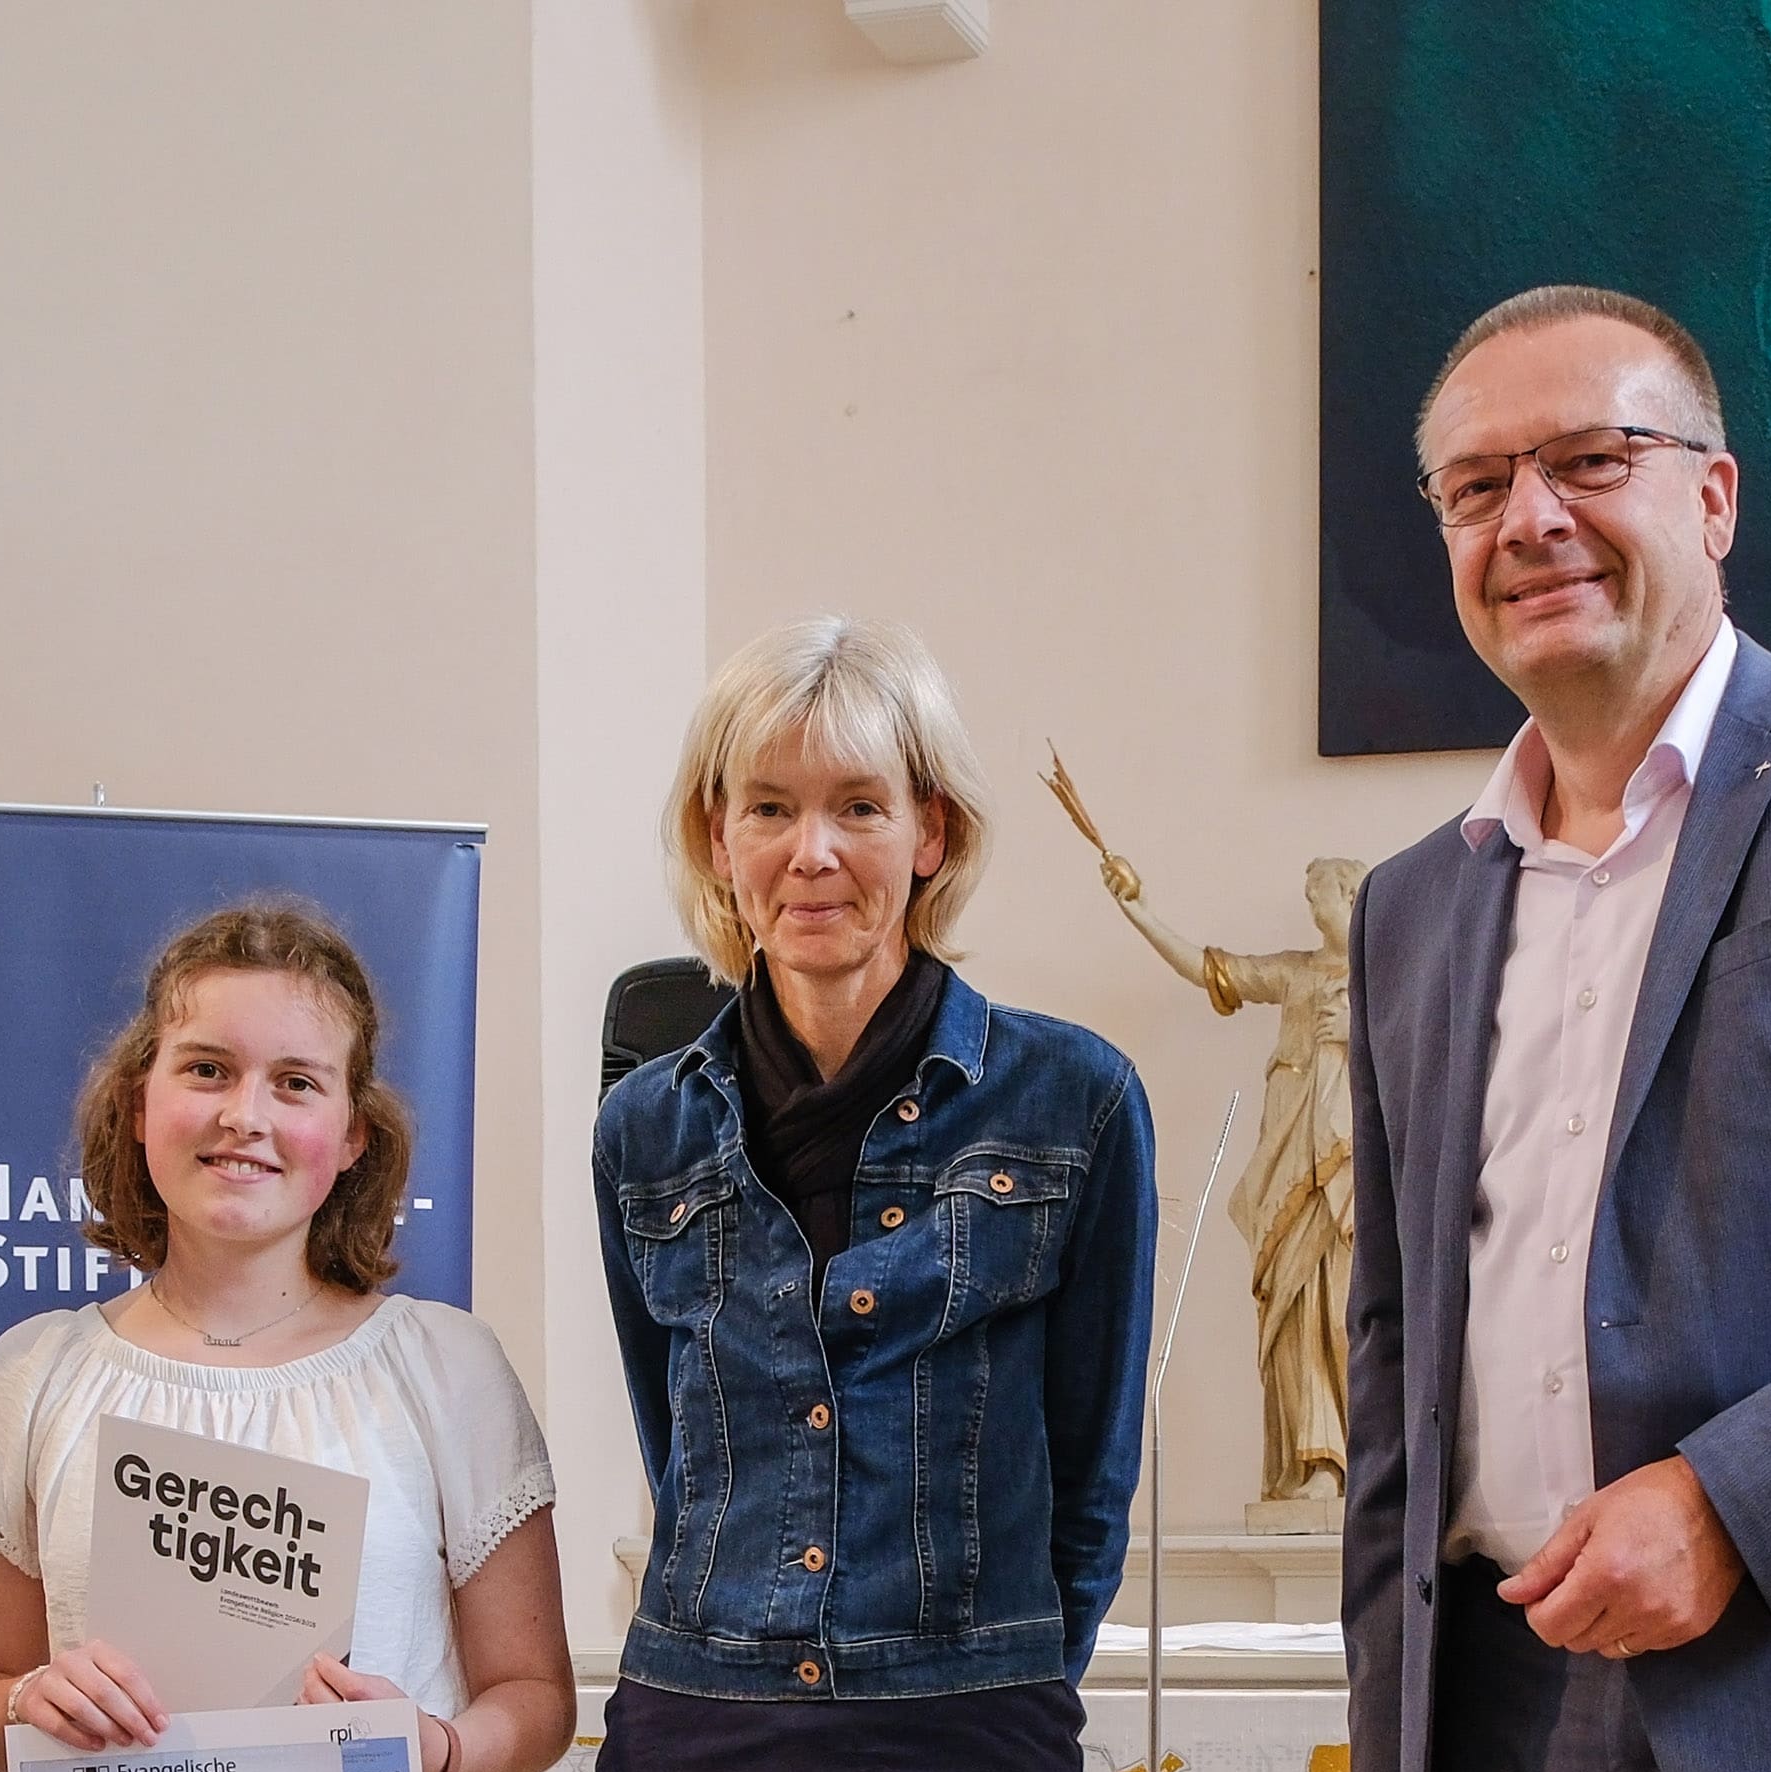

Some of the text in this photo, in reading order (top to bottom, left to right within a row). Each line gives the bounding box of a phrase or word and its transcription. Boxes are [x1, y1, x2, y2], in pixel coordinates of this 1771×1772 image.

[114, 1454, 326, 1540] Gerech-
[149, 1511, 322, 1598] tigkeit
[330, 1723, 353, 1746] rpi
